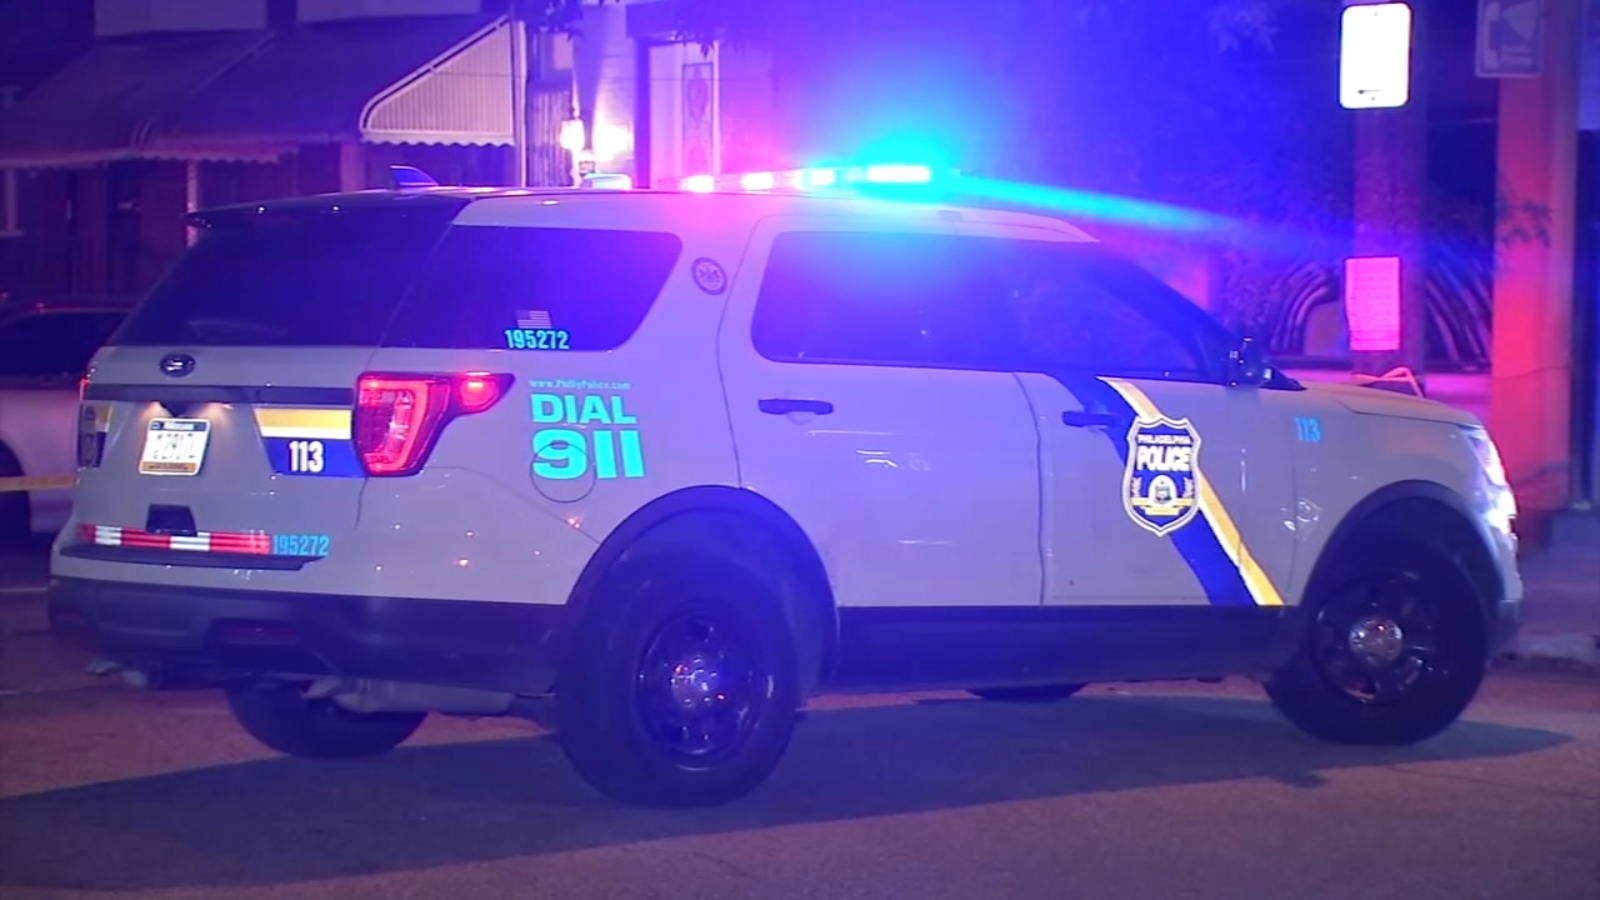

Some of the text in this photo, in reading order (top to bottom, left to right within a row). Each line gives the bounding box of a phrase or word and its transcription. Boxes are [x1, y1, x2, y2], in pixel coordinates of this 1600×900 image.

[504, 329, 570, 350] 195272
[530, 394, 637, 424] DIAL
[1294, 417, 1321, 442] 113
[289, 440, 325, 472] 113
[532, 428, 645, 479] 911
[1137, 445, 1191, 471] POLICE
[273, 534, 330, 556] 195272
